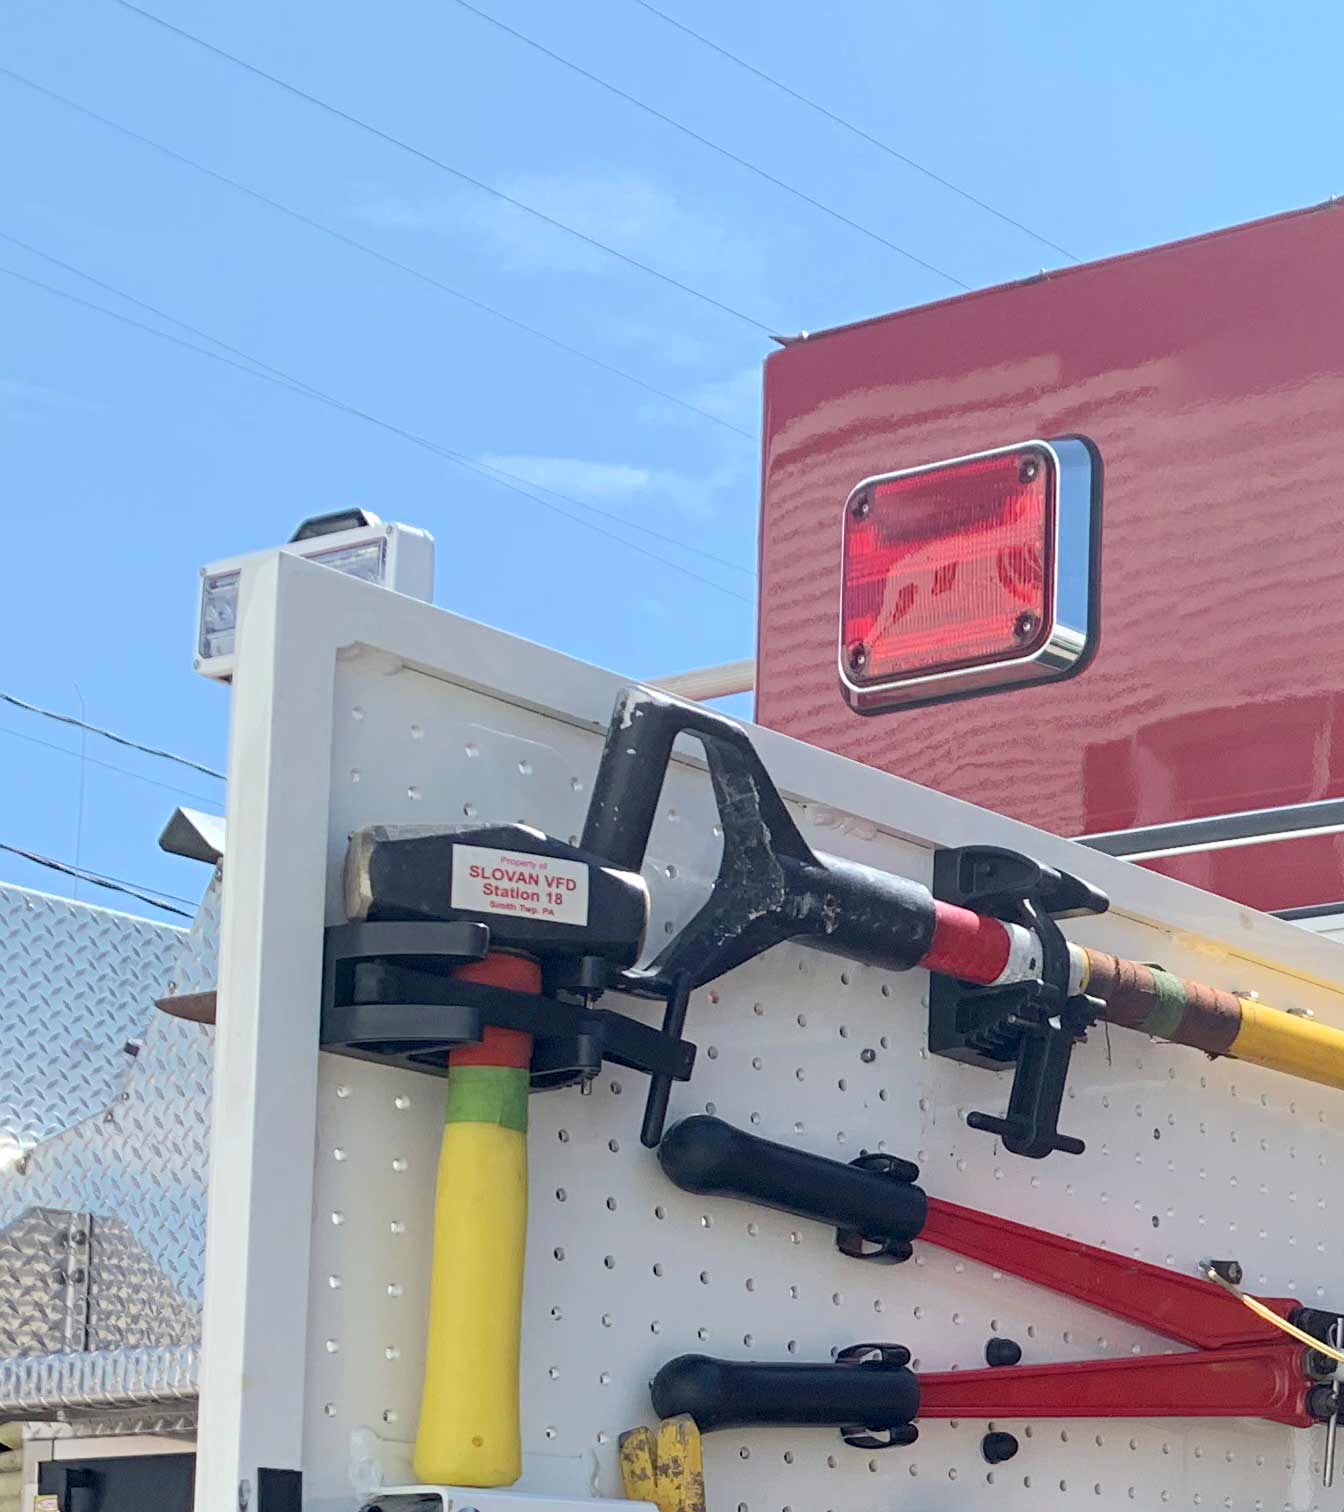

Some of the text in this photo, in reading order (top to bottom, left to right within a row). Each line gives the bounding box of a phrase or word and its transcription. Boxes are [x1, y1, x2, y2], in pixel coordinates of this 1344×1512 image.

[500, 856, 549, 870] Property of
[469, 865, 577, 892] SLOVAN VFD
[482, 882, 563, 905] Station 18
[489, 900, 517, 912] Smith
[542, 907, 555, 917] PA
